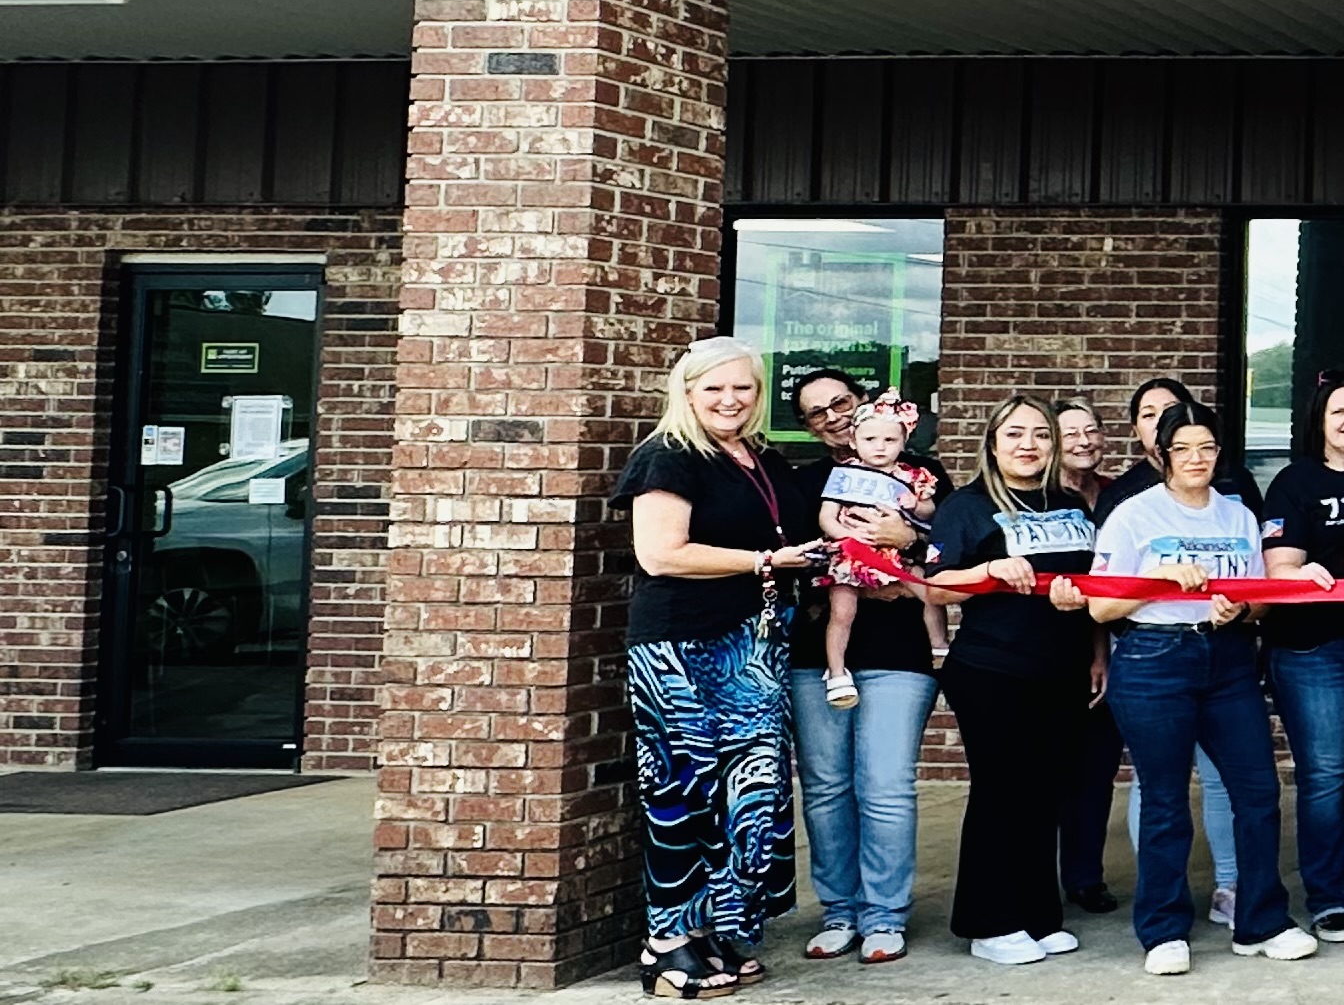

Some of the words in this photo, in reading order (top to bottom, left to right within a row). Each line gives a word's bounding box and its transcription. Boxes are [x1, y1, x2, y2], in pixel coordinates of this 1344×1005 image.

[784, 320, 813, 335] The
[817, 320, 878, 338] original
[1011, 522, 1049, 545] FAT
[1058, 520, 1094, 542] TN
[1213, 554, 1248, 579] TNY
